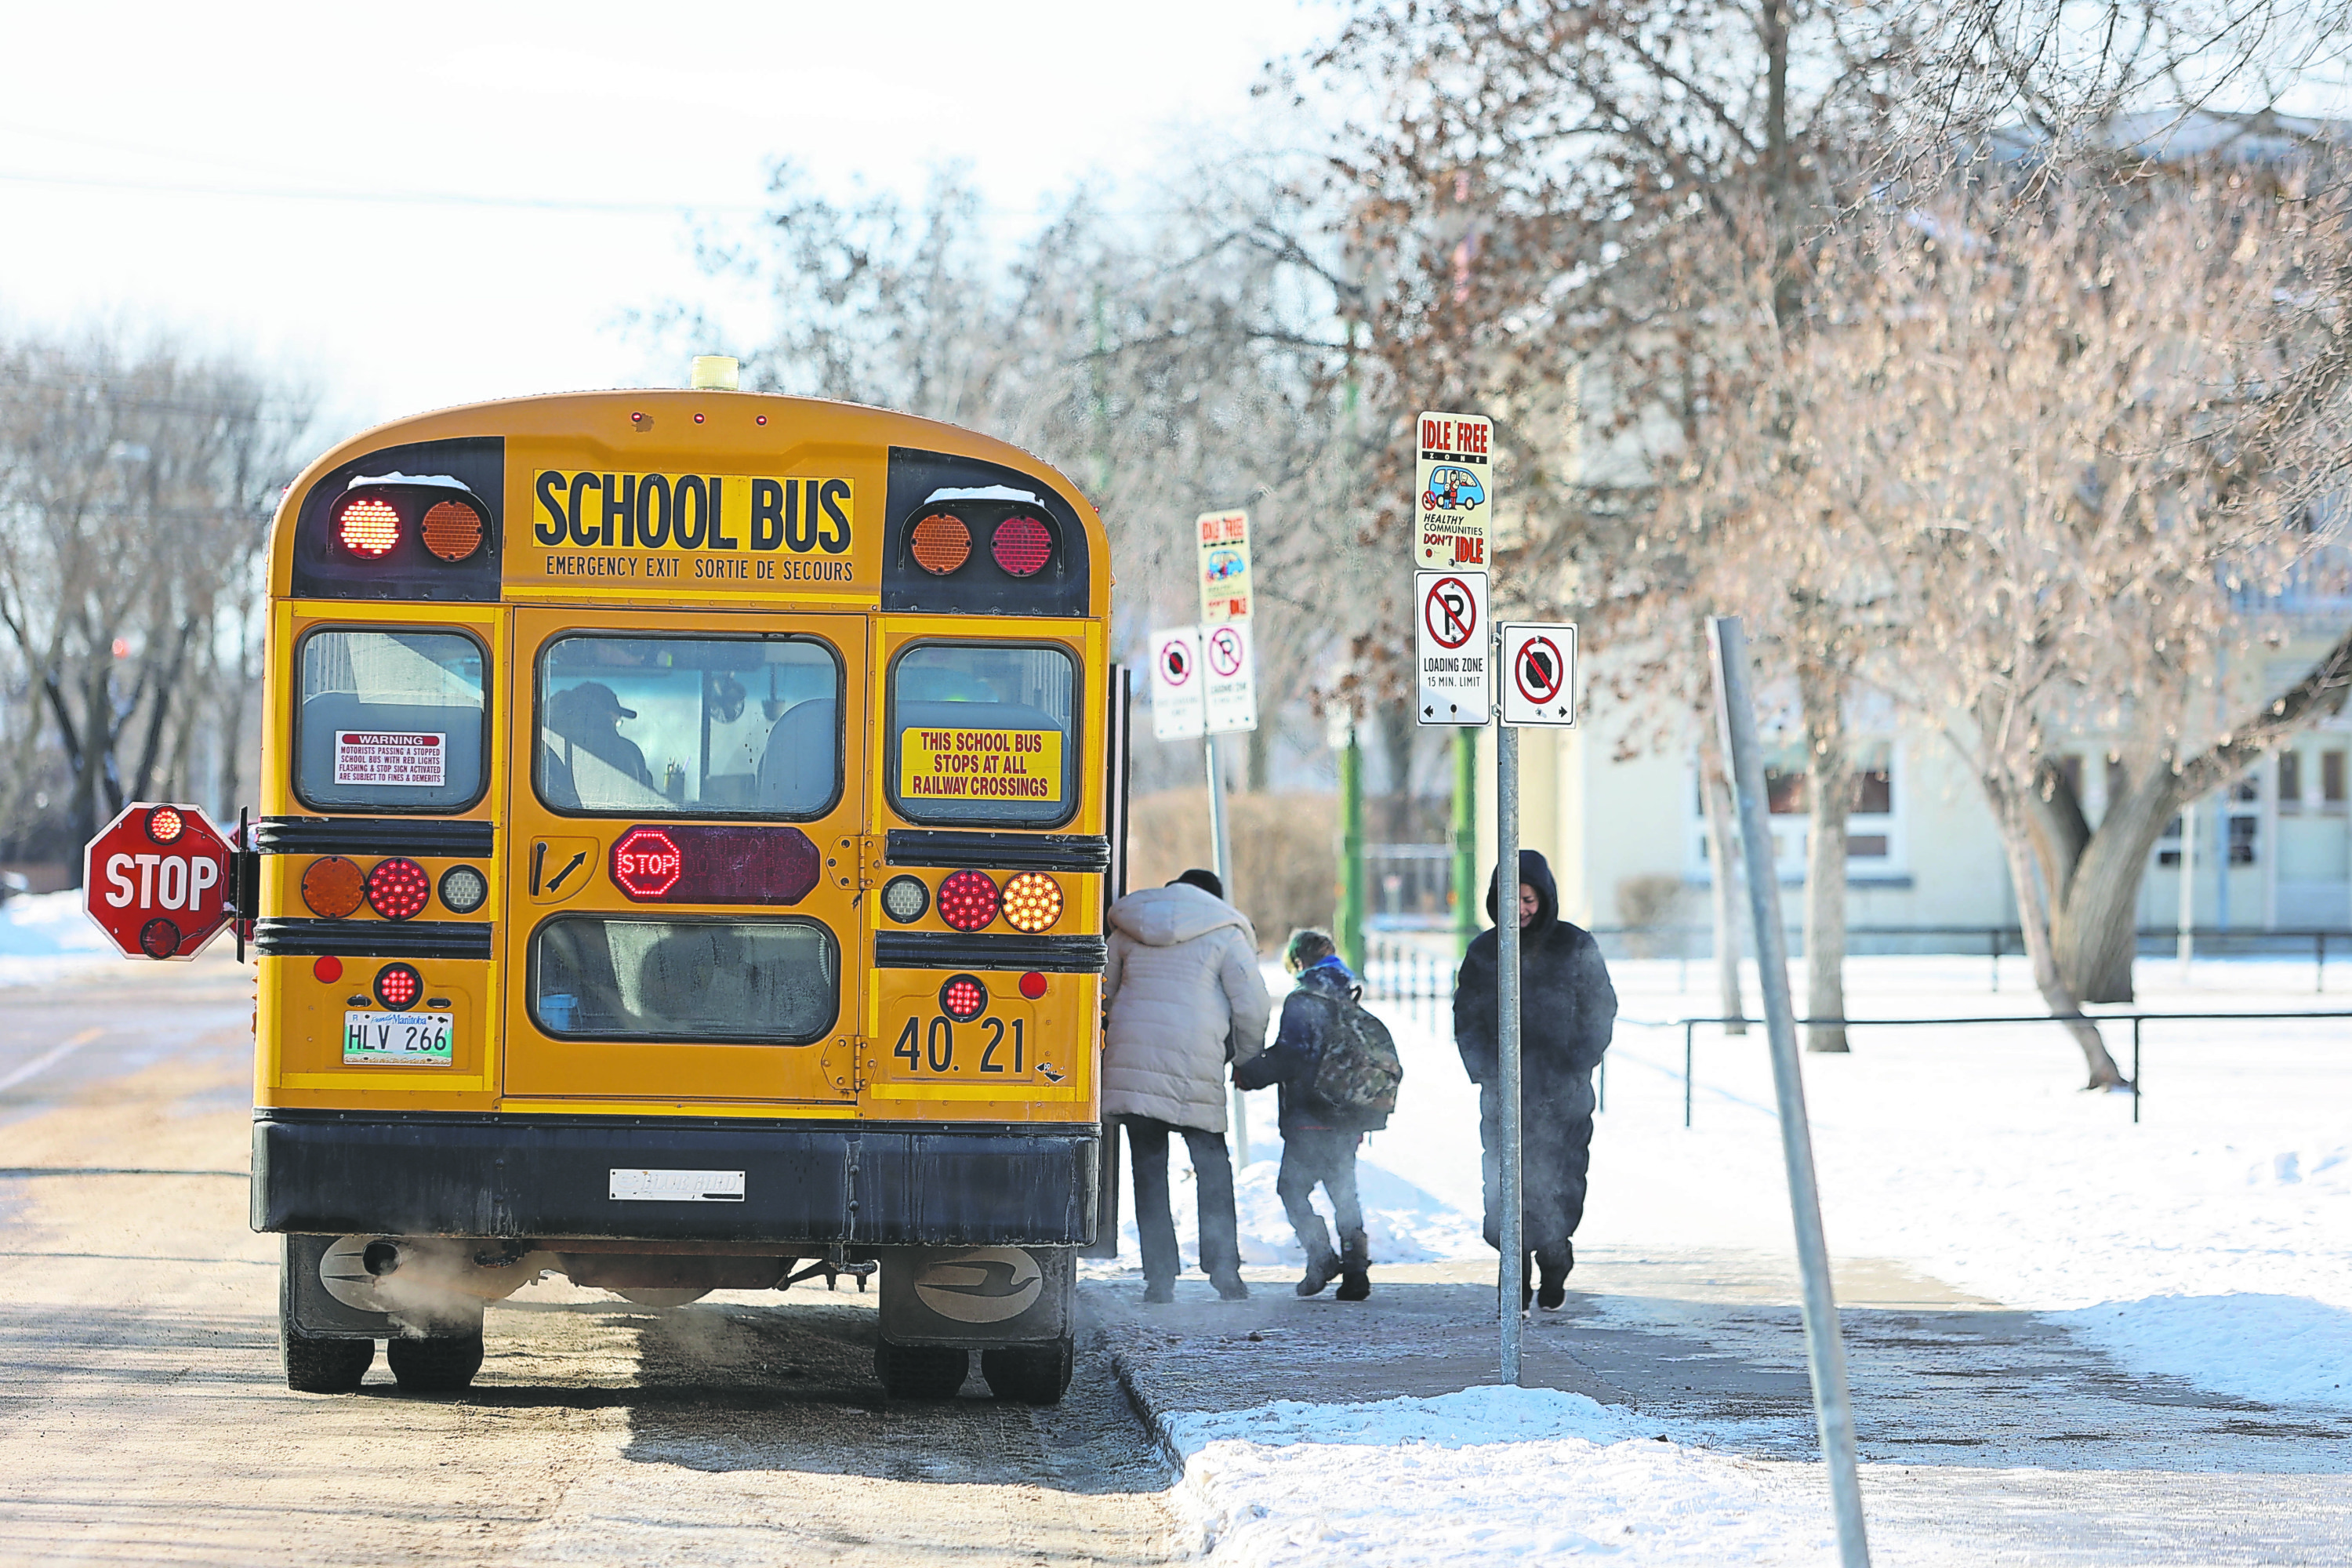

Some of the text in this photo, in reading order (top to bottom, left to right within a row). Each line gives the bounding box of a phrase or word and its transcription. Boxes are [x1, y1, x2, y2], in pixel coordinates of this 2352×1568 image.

[1422, 419, 1487, 453] IDLE FREE
[1429, 453, 1479, 463] ZONE
[534, 470, 851, 554] SCHOOL BUS
[1424, 514, 1465, 524] HEALTHY
[1424, 524, 1483, 535] COMMUNITIES
[1424, 533, 1483, 564] DON'T IDLE
[546, 556, 853, 582] EMERGENCY EXIT SORTIE DE SECOURS
[1424, 658, 1483, 672] LOADING ZONE
[1428, 677, 1480, 687] 15 MIN. LIMIT
[358, 735, 423, 745] WARNING
[921, 731, 1042, 753] THIS SCHOOL BUS
[413, 748, 440, 757] STOPPED
[339, 764, 368, 772] FLASHING
[376, 764, 391, 773] STOP
[410, 765, 441, 774] ACTIVATED
[934, 754, 1026, 774] STOPS AT ALL
[339, 772, 350, 781] ARE
[913, 775, 1047, 797] RAILWAY CROSSINGS
[622, 854, 675, 875] STOP
[105, 853, 218, 911] STOP
[392, 1014, 426, 1025] Manitoba
[349, 1025, 446, 1051] HLV 266
[979, 1017, 1023, 1073] 21
